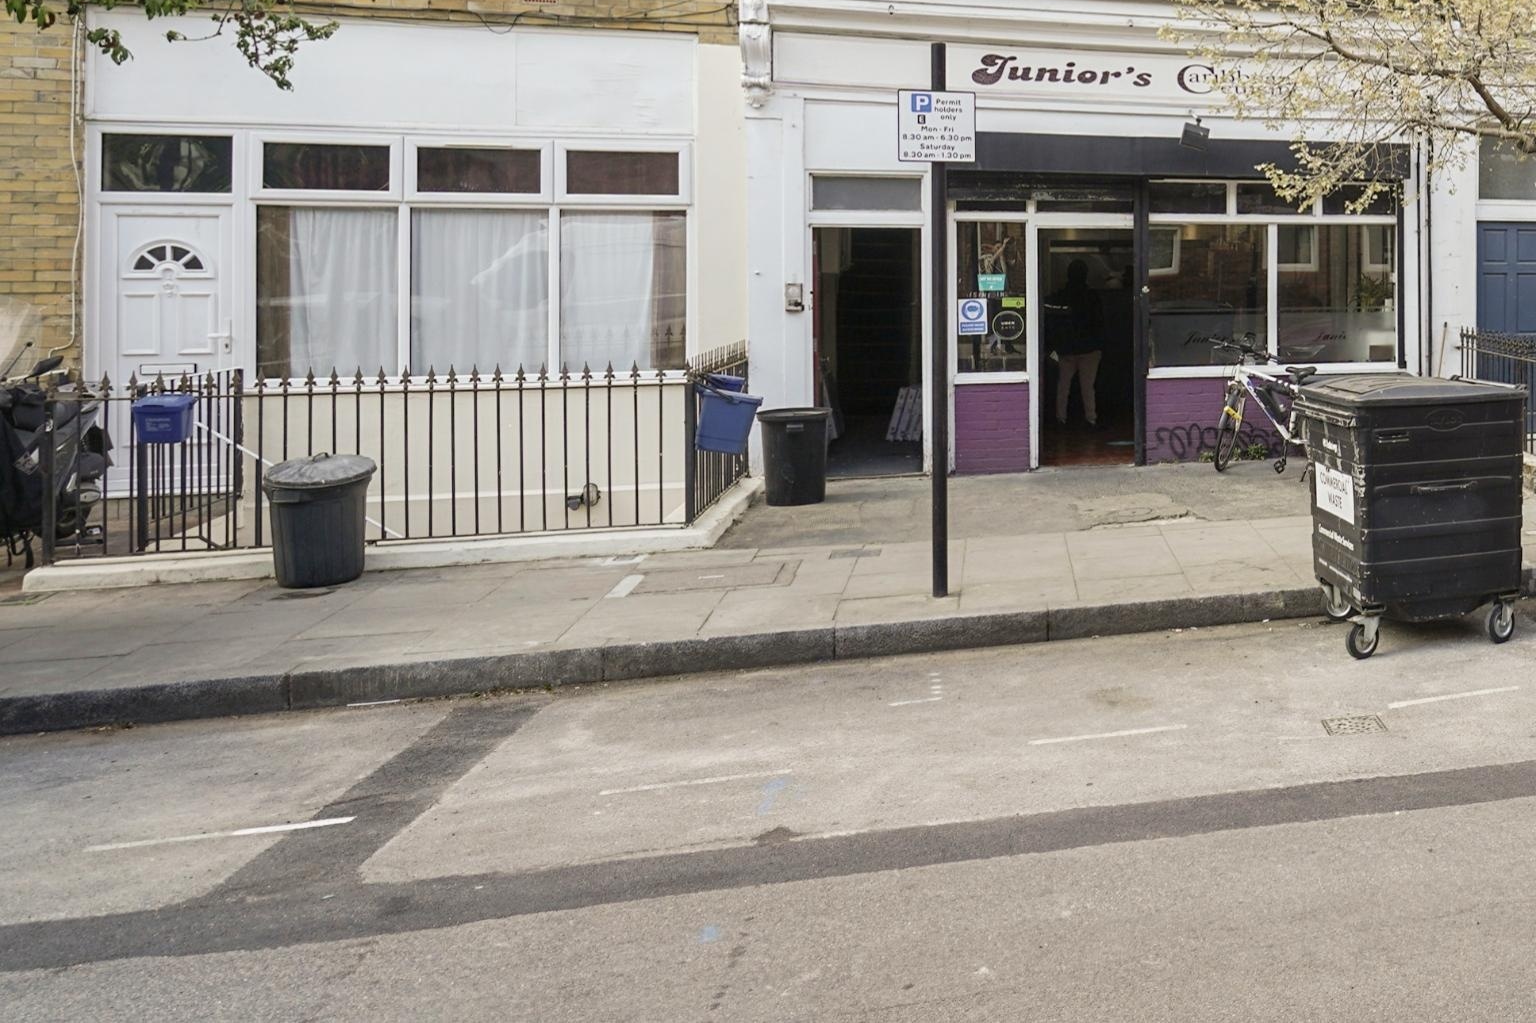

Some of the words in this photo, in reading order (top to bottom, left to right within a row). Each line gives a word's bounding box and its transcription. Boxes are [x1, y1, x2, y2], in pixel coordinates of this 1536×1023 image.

[971, 54, 1152, 88] Junior's
[916, 95, 930, 111] P
[936, 98, 961, 106] Permit
[902, 133, 921, 141] 8.30
[920, 143, 955, 151] Saturday
[1320, 471, 1348, 495] COMMERCIAL
[1327, 492, 1342, 509] WASTE
